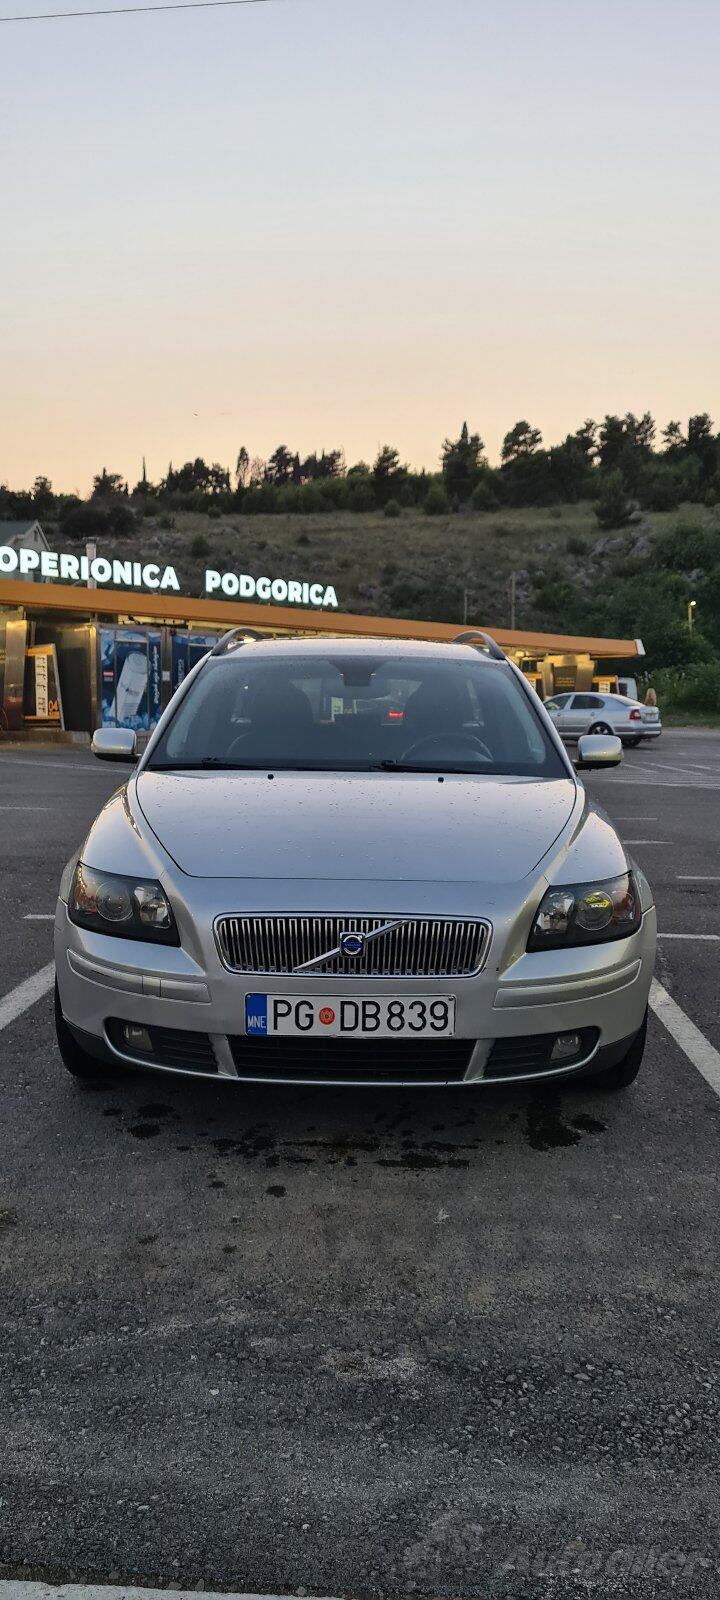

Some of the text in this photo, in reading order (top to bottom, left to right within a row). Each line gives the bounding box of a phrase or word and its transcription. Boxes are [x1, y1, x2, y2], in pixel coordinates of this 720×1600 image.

[0, 546, 338, 607] OPERIONICA PODGORICA
[248, 1015, 266, 1029] MNE
[273, 1000, 314, 1031] PG
